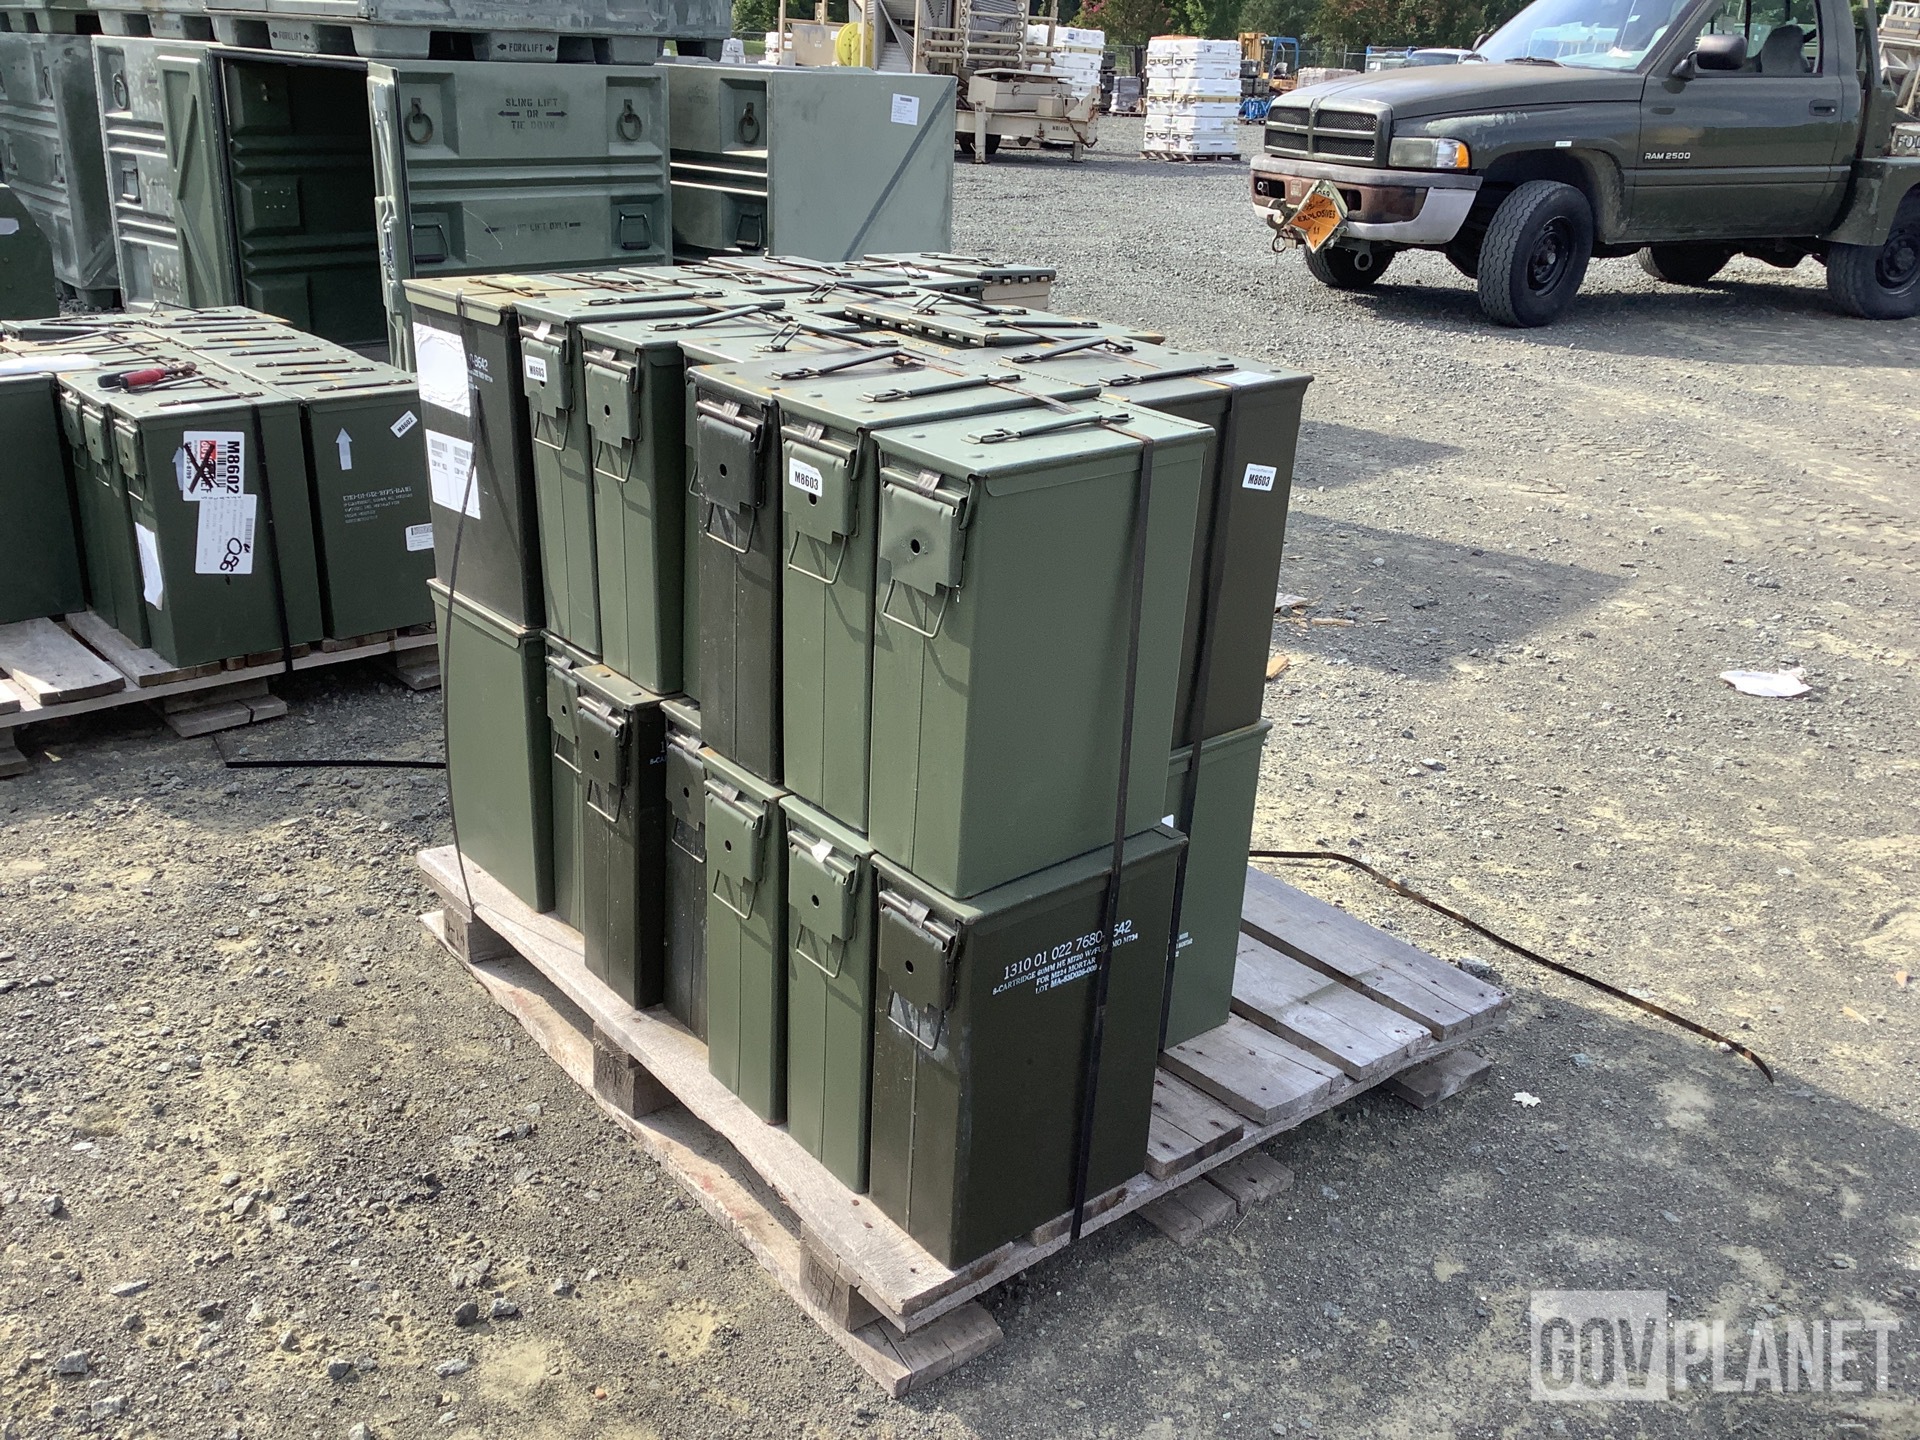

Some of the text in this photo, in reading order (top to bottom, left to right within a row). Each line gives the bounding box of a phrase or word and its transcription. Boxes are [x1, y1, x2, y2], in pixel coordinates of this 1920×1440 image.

[509, 43, 543, 52] FORKLIFT
[505, 98, 558, 107] SLING LIFT
[527, 109, 539, 118] OR
[511, 120, 525, 129] TIE
[1644, 152, 1691, 160] RAM 2500
[1297, 210, 1336, 222] EXPLOSIVES
[226, 440, 240, 494] M8602
[795, 470, 818, 490] M8603
[1248, 474, 1271, 487] M8603
[1003, 957, 1032, 980] 1310
[1034, 951, 1047, 968] 01
[1051, 942, 1073, 961] 022
[1056, 959, 1066, 969] HE
[1036, 974, 1050, 986] FOR
[1068, 956, 1096, 973] MORTAR
[1035, 983, 1049, 994] LOT
